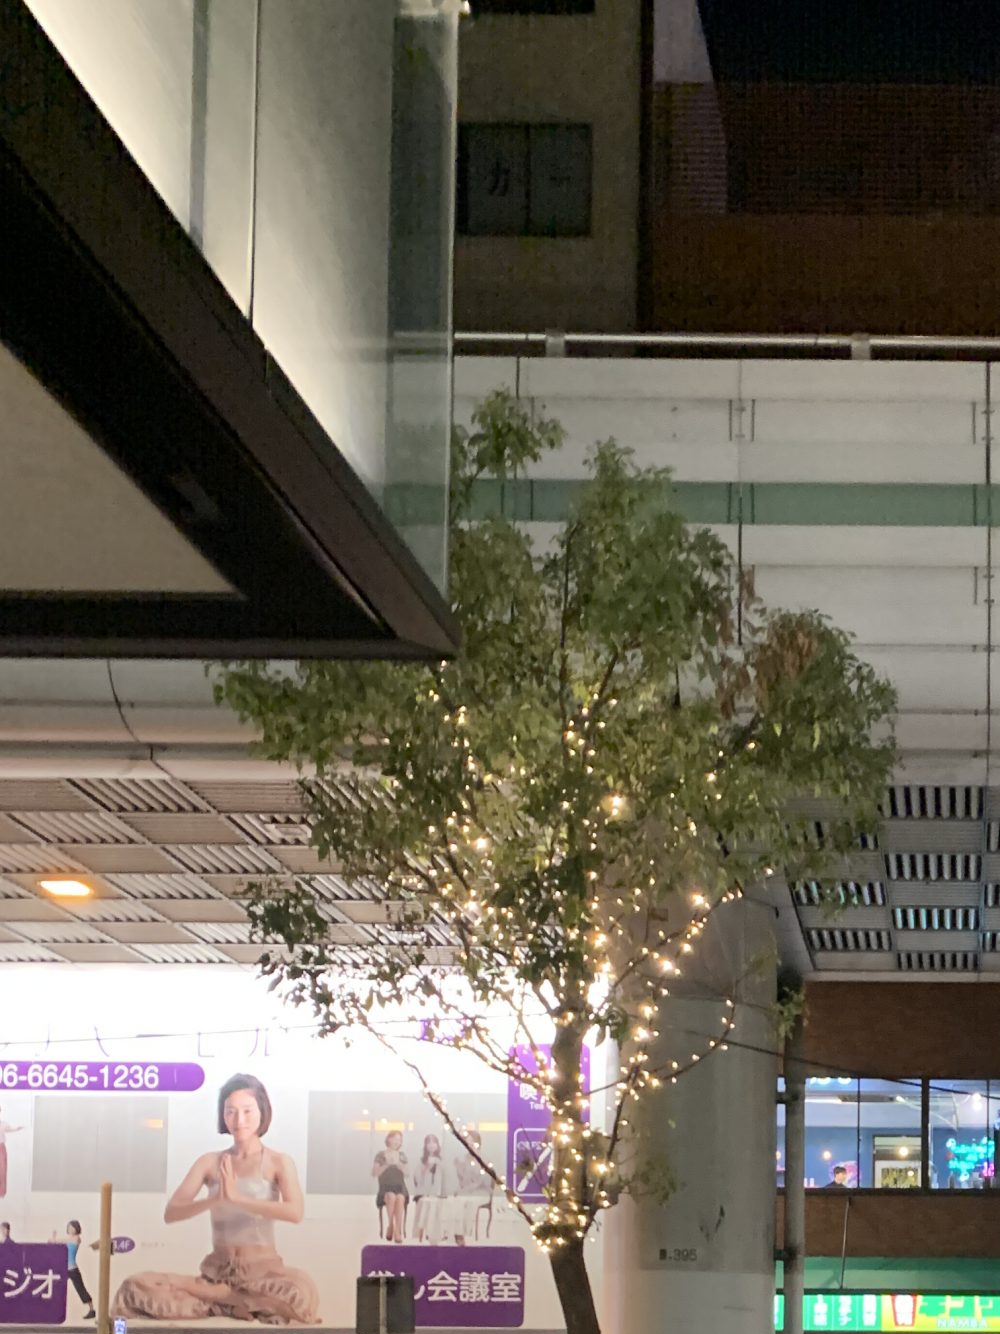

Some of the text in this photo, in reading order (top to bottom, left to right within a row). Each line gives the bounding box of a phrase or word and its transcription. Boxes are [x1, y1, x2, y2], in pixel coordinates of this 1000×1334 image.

[0, 1063, 160, 1089] 6-6645-1236
[367, 1270, 522, 1303] 会議室
[936, 1318, 988, 1329] NAMBA
